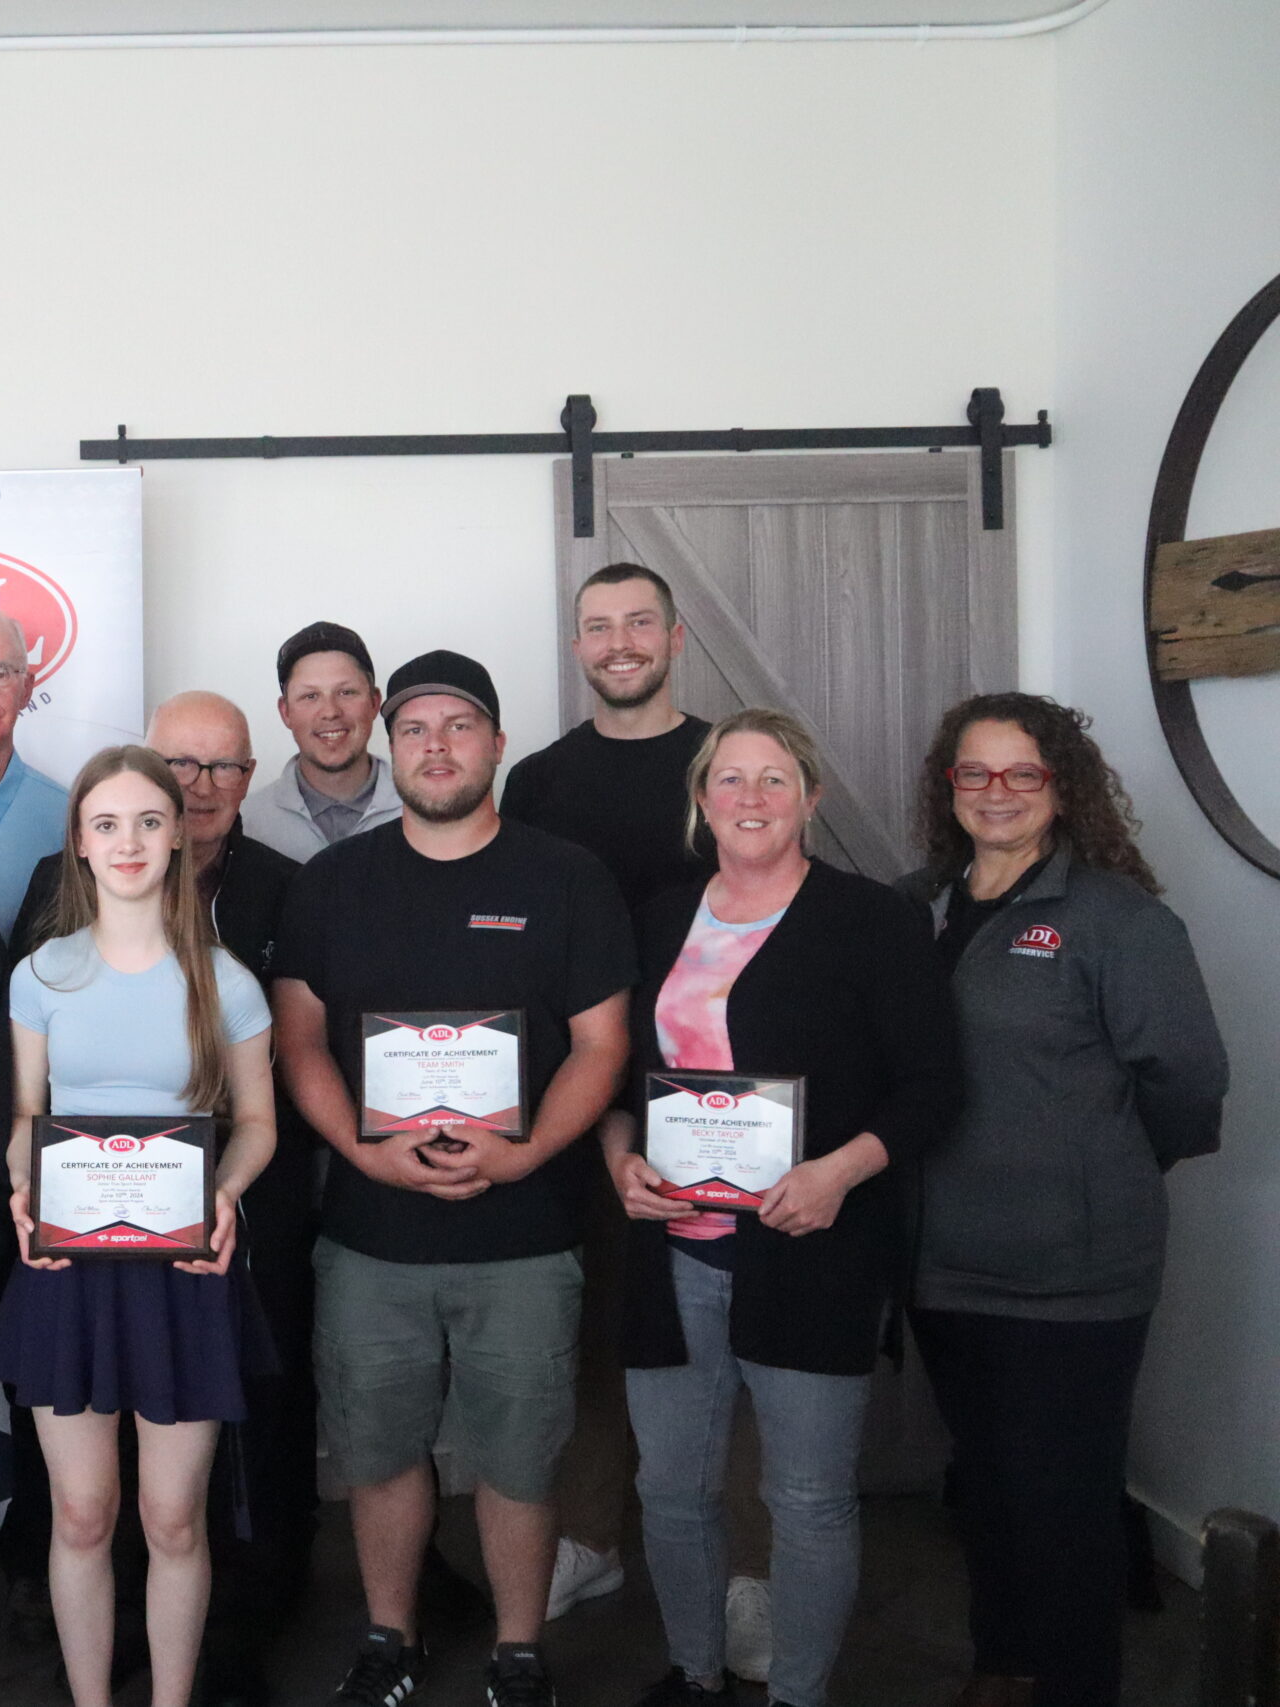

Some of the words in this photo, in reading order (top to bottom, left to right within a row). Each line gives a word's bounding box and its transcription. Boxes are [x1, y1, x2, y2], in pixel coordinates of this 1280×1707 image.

[431, 1030, 451, 1039] ADL
[432, 1050, 442, 1058] OF
[444, 1049, 498, 1057] ACHIEVEMENT
[709, 1096, 729, 1105] ADL
[665, 1116, 707, 1126] CERTIFICATE
[709, 1118, 720, 1126] OF
[721, 1119, 773, 1128] ACHIEVEMENT
[111, 1141, 135, 1149] ADL
[86, 1173, 116, 1181] SOPHIE
[118, 1173, 157, 1181] GALLANT
